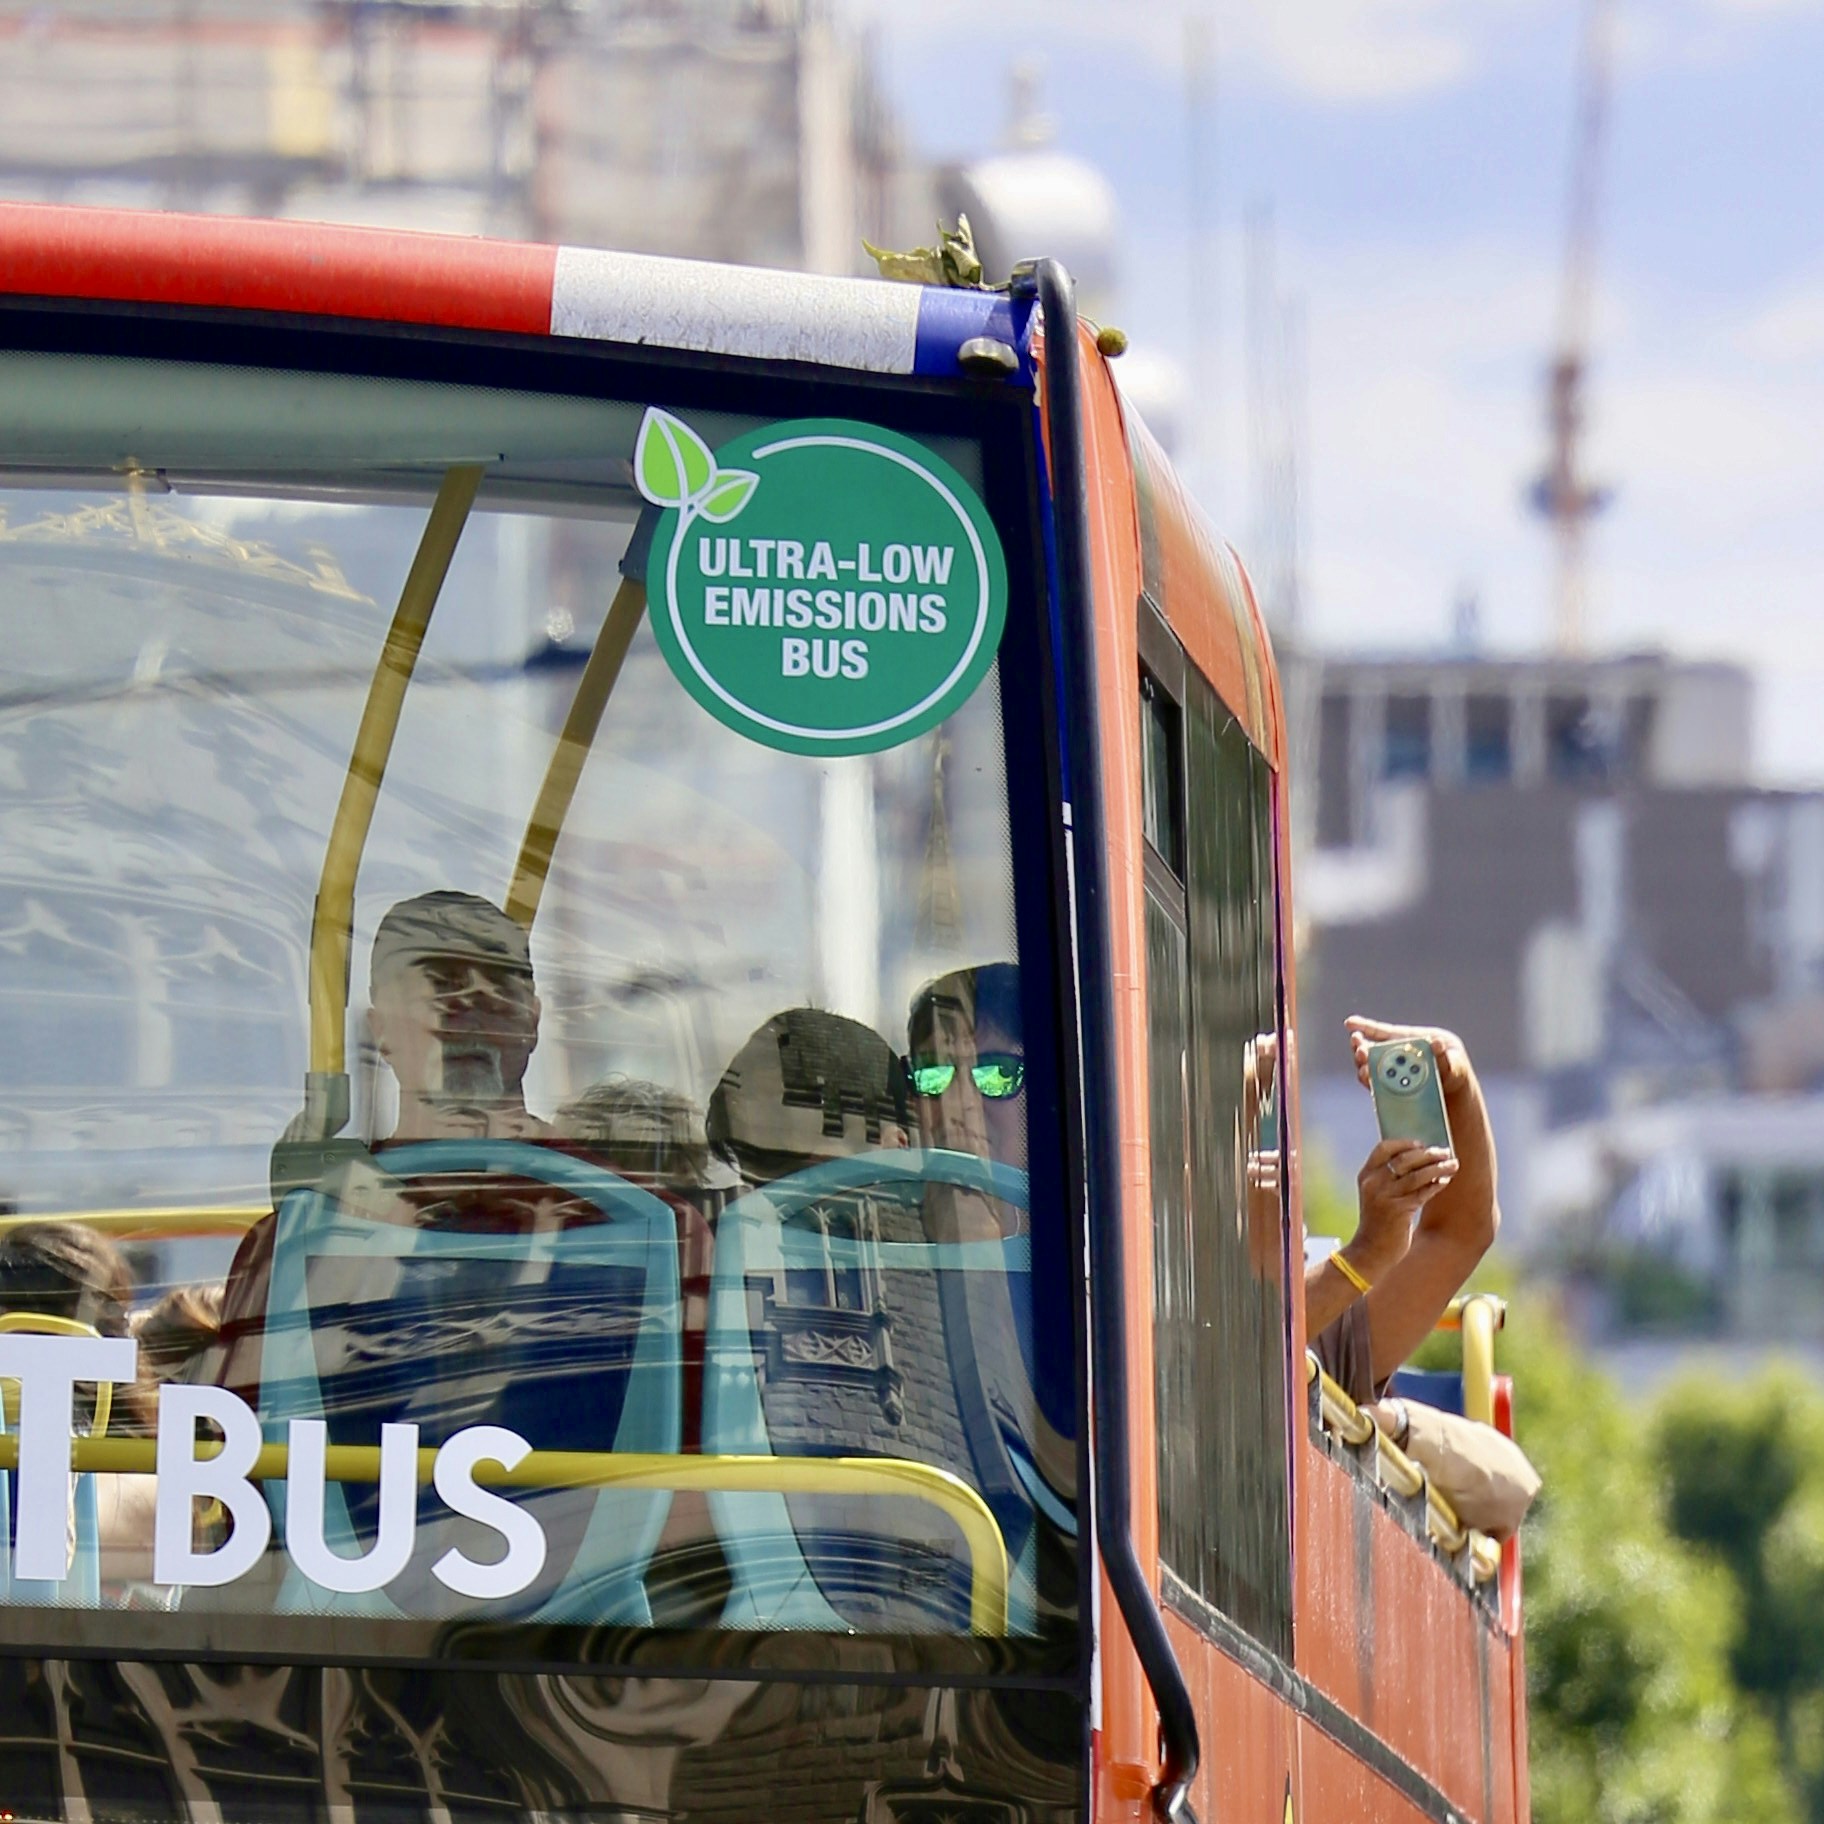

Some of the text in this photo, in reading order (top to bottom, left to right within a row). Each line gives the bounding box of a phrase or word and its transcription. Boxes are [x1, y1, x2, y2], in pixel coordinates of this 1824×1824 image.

[699, 537, 955, 585] ULTRA-LOW
[704, 586, 948, 634] EMISSIONS
[781, 638, 869, 680] BUS
